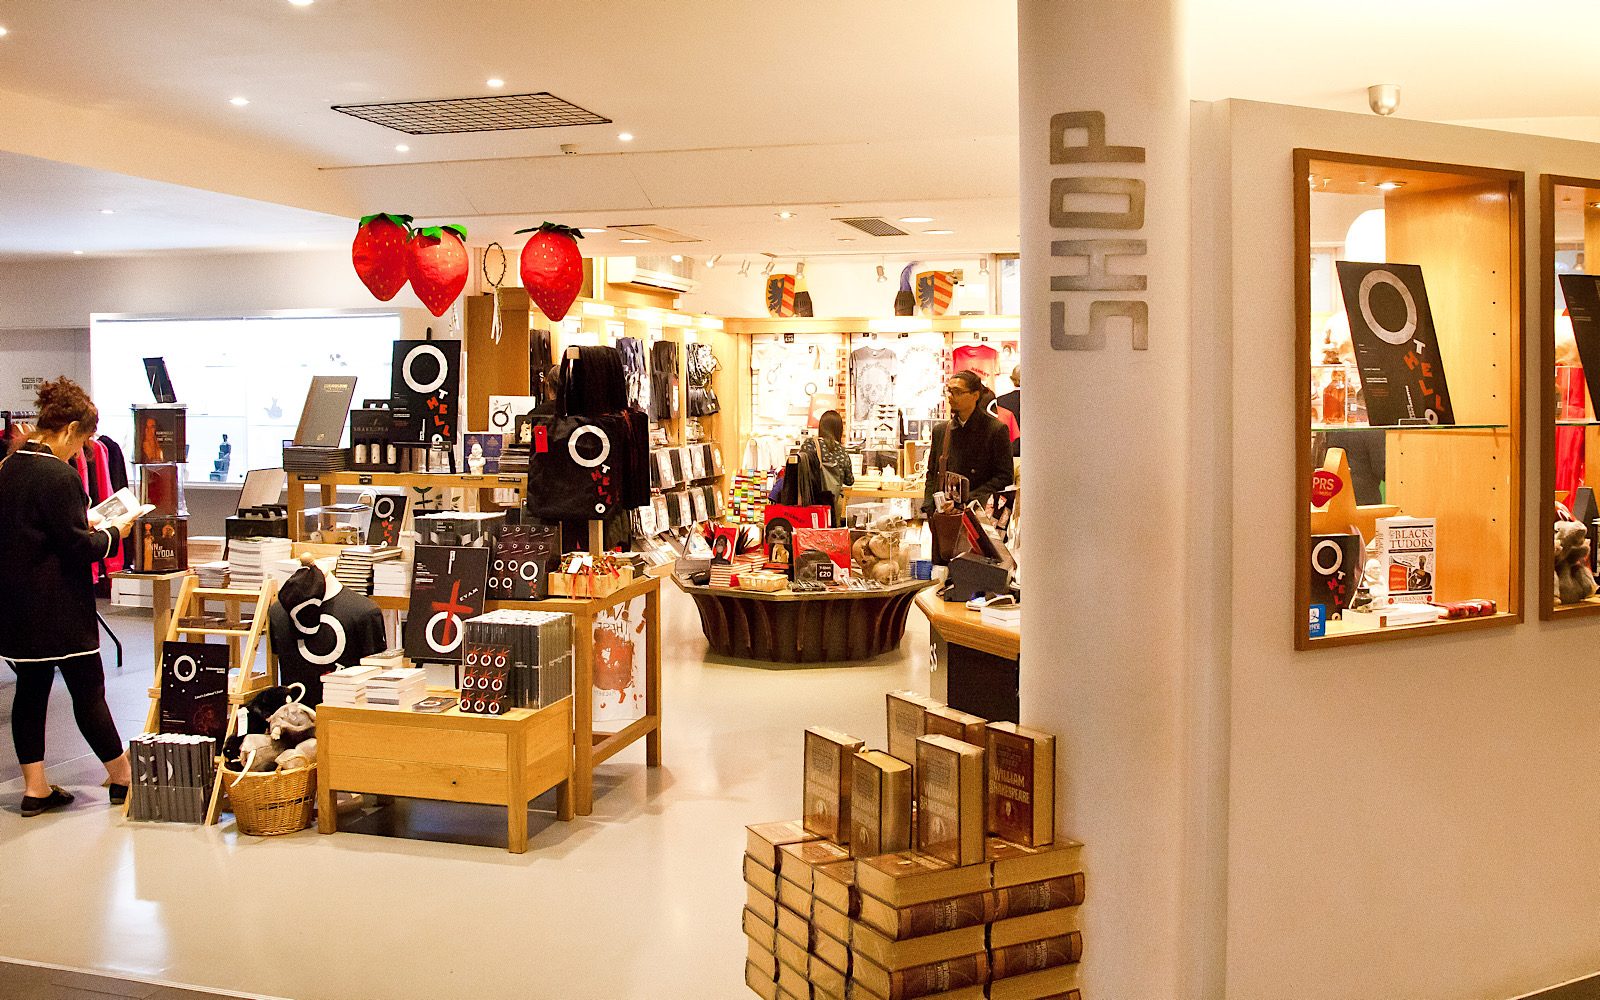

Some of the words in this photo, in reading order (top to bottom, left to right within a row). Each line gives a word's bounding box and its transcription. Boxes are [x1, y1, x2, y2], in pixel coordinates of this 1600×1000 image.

[1049, 110, 1149, 351] SHOP
[1312, 476, 1335, 491] PRS
[1394, 528, 1429, 539] BLACK
[1390, 538, 1433, 549] TUDORS
[153, 550, 175, 558] LYDDA
[459, 587, 479, 602] EYAM
[993, 765, 1025, 788] WILLIAM
